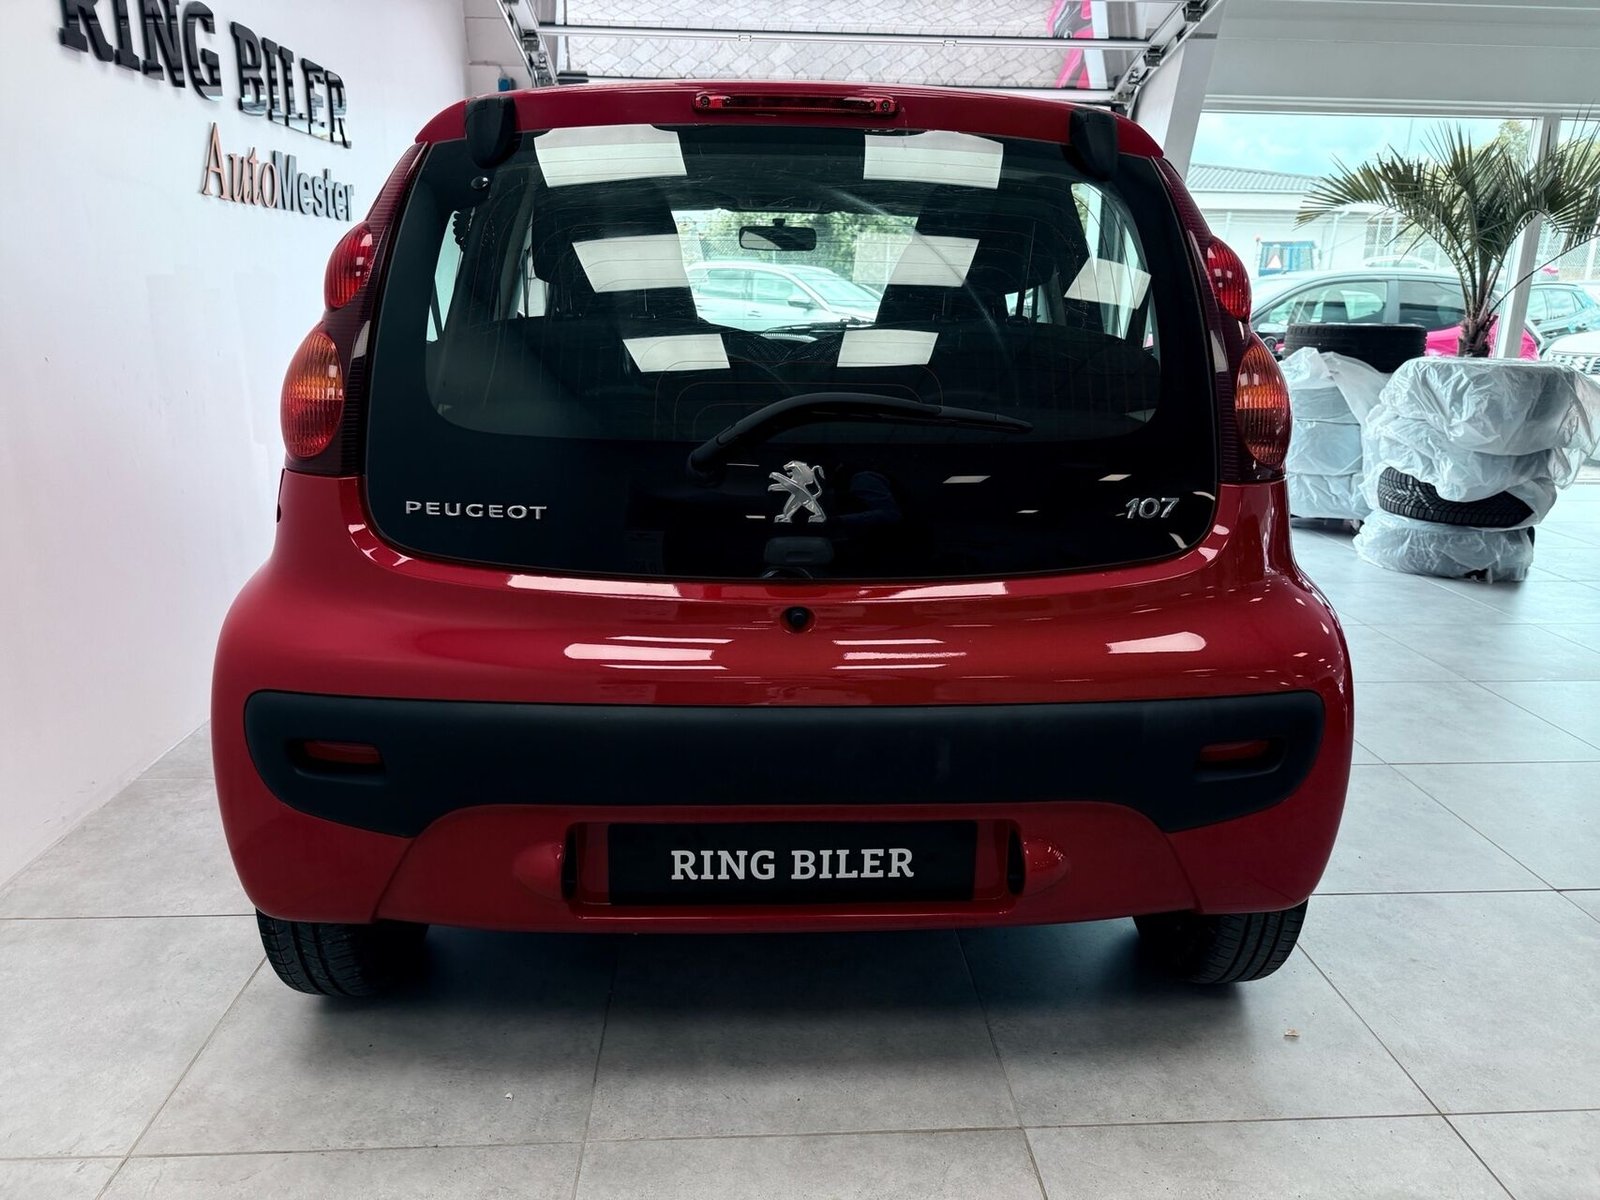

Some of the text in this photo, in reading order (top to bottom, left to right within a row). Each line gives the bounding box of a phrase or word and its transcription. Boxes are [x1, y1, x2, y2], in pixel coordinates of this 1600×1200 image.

[230, 21, 352, 149] BILER
[200, 121, 354, 222] AutoMester
[404, 500, 548, 521] PEUGEOT
[1125, 497, 1180, 519] 107
[671, 848, 915, 880] RING BILER
